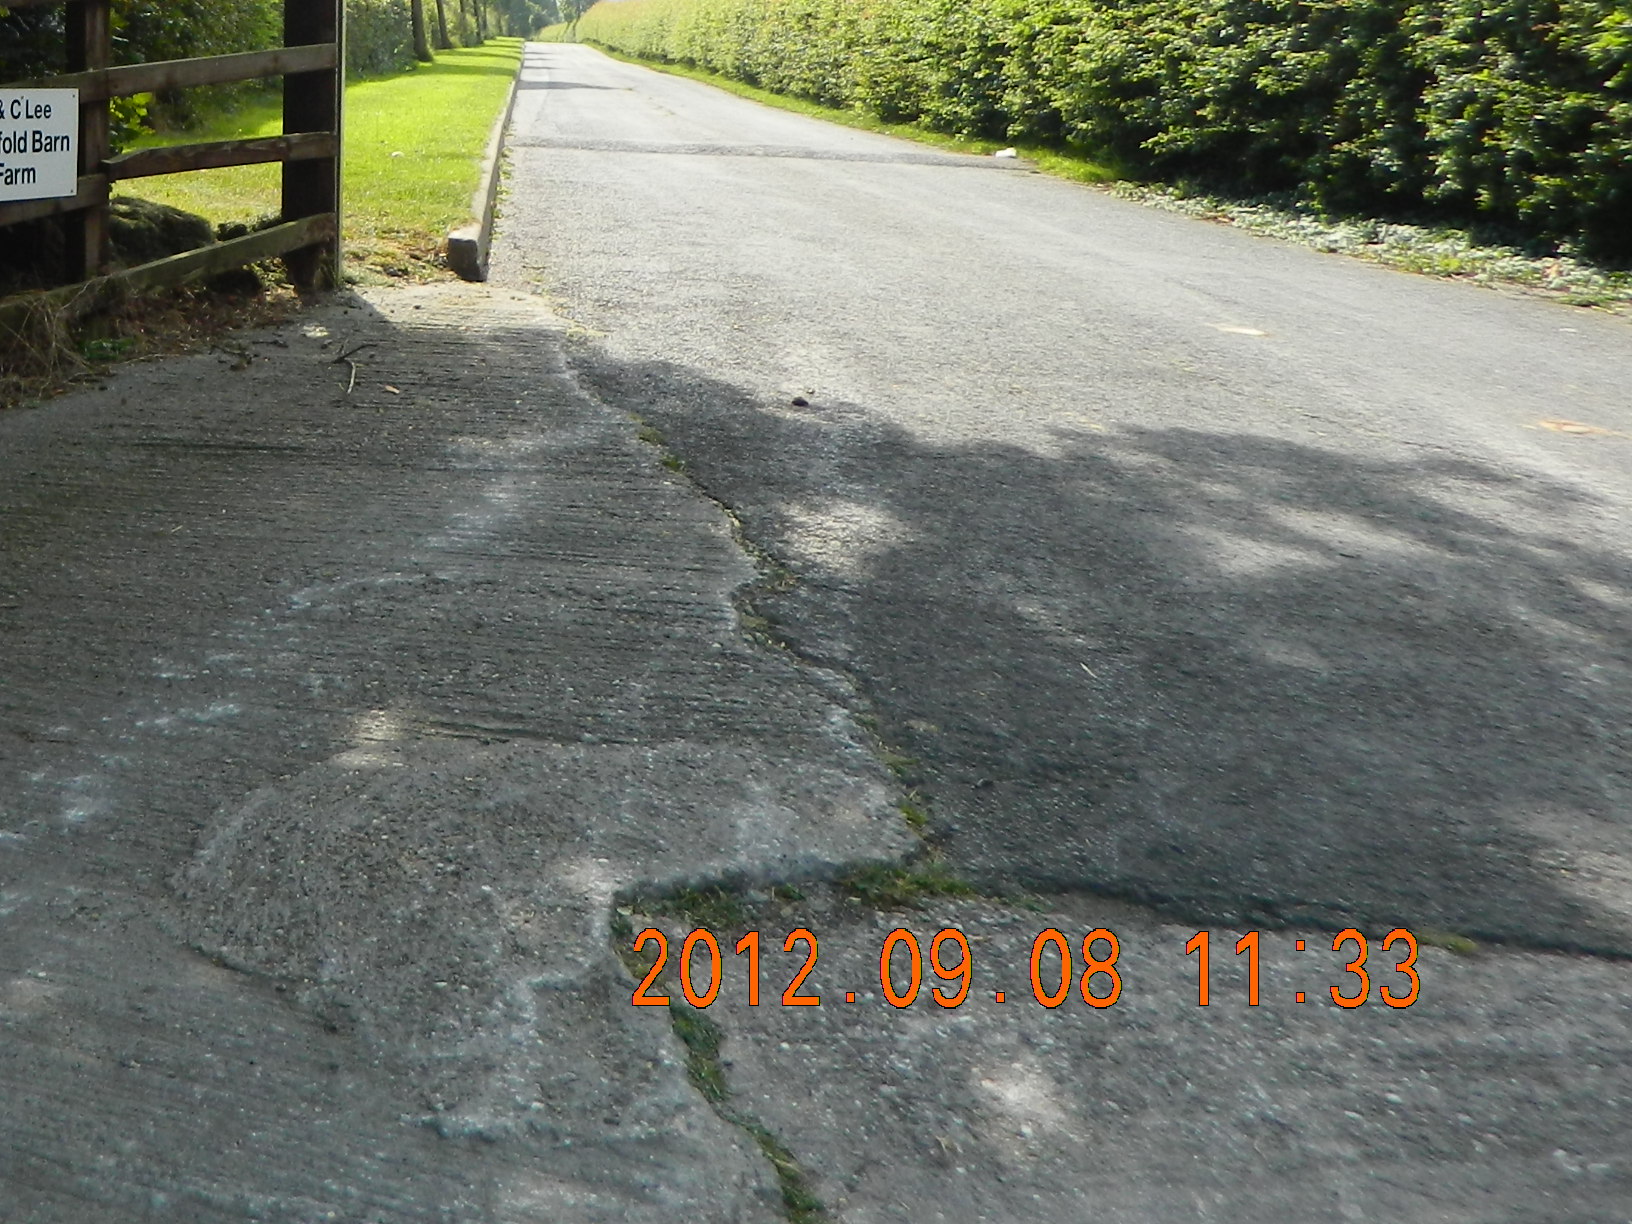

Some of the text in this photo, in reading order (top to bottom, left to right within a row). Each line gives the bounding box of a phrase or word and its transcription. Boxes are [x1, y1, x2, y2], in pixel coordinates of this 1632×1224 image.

[10, 99, 22, 119] C
[25, 99, 52, 119] Lee
[32, 130, 70, 153] Barn
